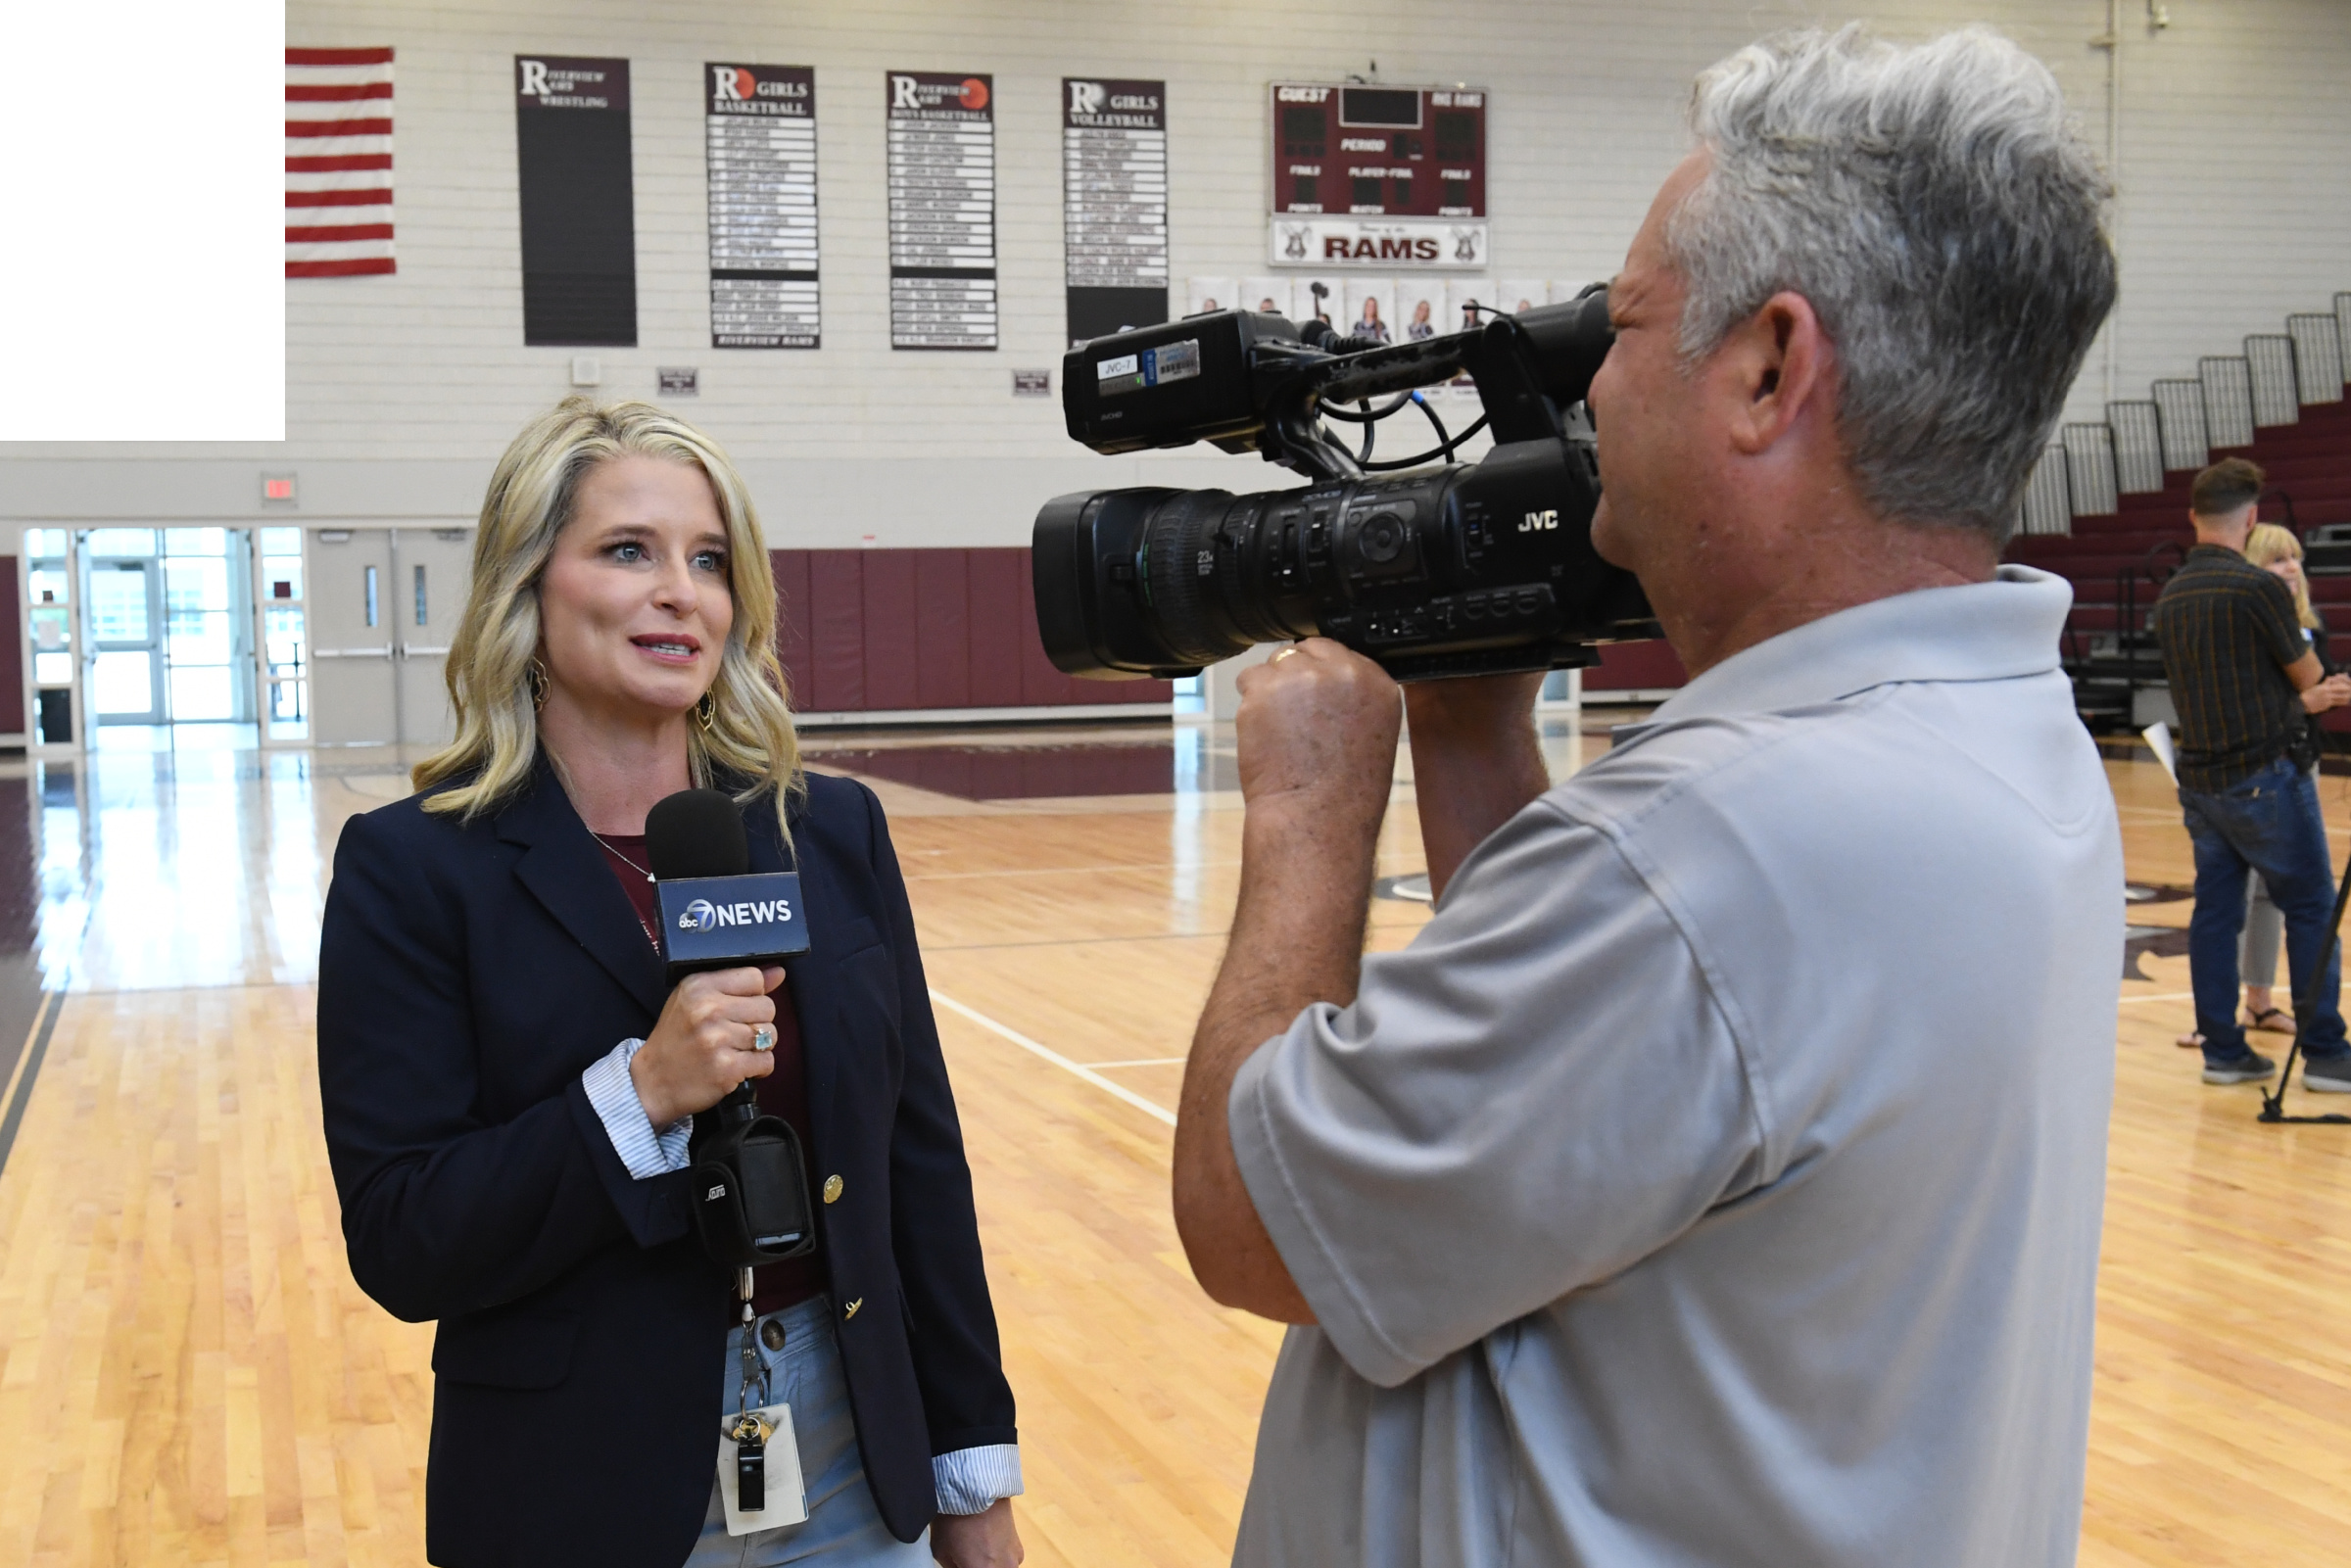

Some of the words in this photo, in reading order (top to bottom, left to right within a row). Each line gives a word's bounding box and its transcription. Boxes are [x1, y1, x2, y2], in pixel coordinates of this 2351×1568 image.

[756, 81, 808, 98] GIRLS
[1277, 87, 1331, 103] GUEST
[540, 95, 608, 109] WRESTLING
[714, 100, 807, 116] BASKETBALL
[1110, 95, 1160, 111] GIRLS
[1070, 114, 1159, 128] VOLLEYBALL
[1340, 138, 1387, 153] PERIOD
[1324, 237, 1439, 260] RAMS
[1105, 359, 1131, 374] JVC-7
[1517, 509, 1559, 532] JVC
[687, 899, 716, 932] 7
[716, 899, 792, 927] NEWS
[679, 917, 699, 928] abc
